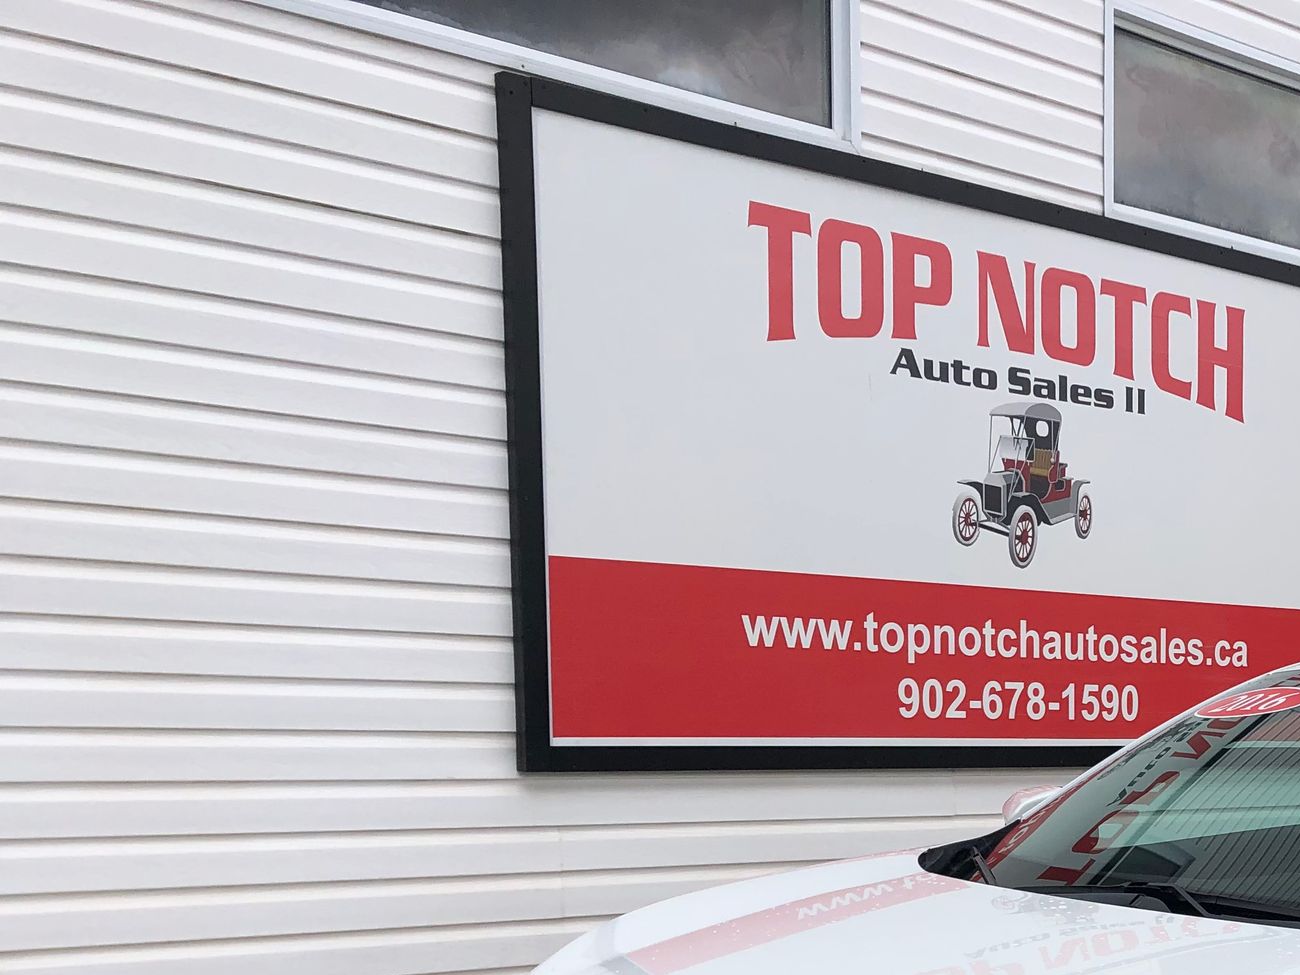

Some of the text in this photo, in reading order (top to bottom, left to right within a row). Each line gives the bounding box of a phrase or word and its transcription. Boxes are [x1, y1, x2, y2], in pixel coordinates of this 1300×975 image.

[747, 199, 1247, 424] TOP NOTCH
[889, 347, 999, 391] Auto
[1007, 365, 1115, 410] Sales
[741, 612, 1249, 668] www.topnotchautosales.ca
[897, 678, 1140, 722] 902-678-1590
[1208, 692, 1300, 713] 2016
